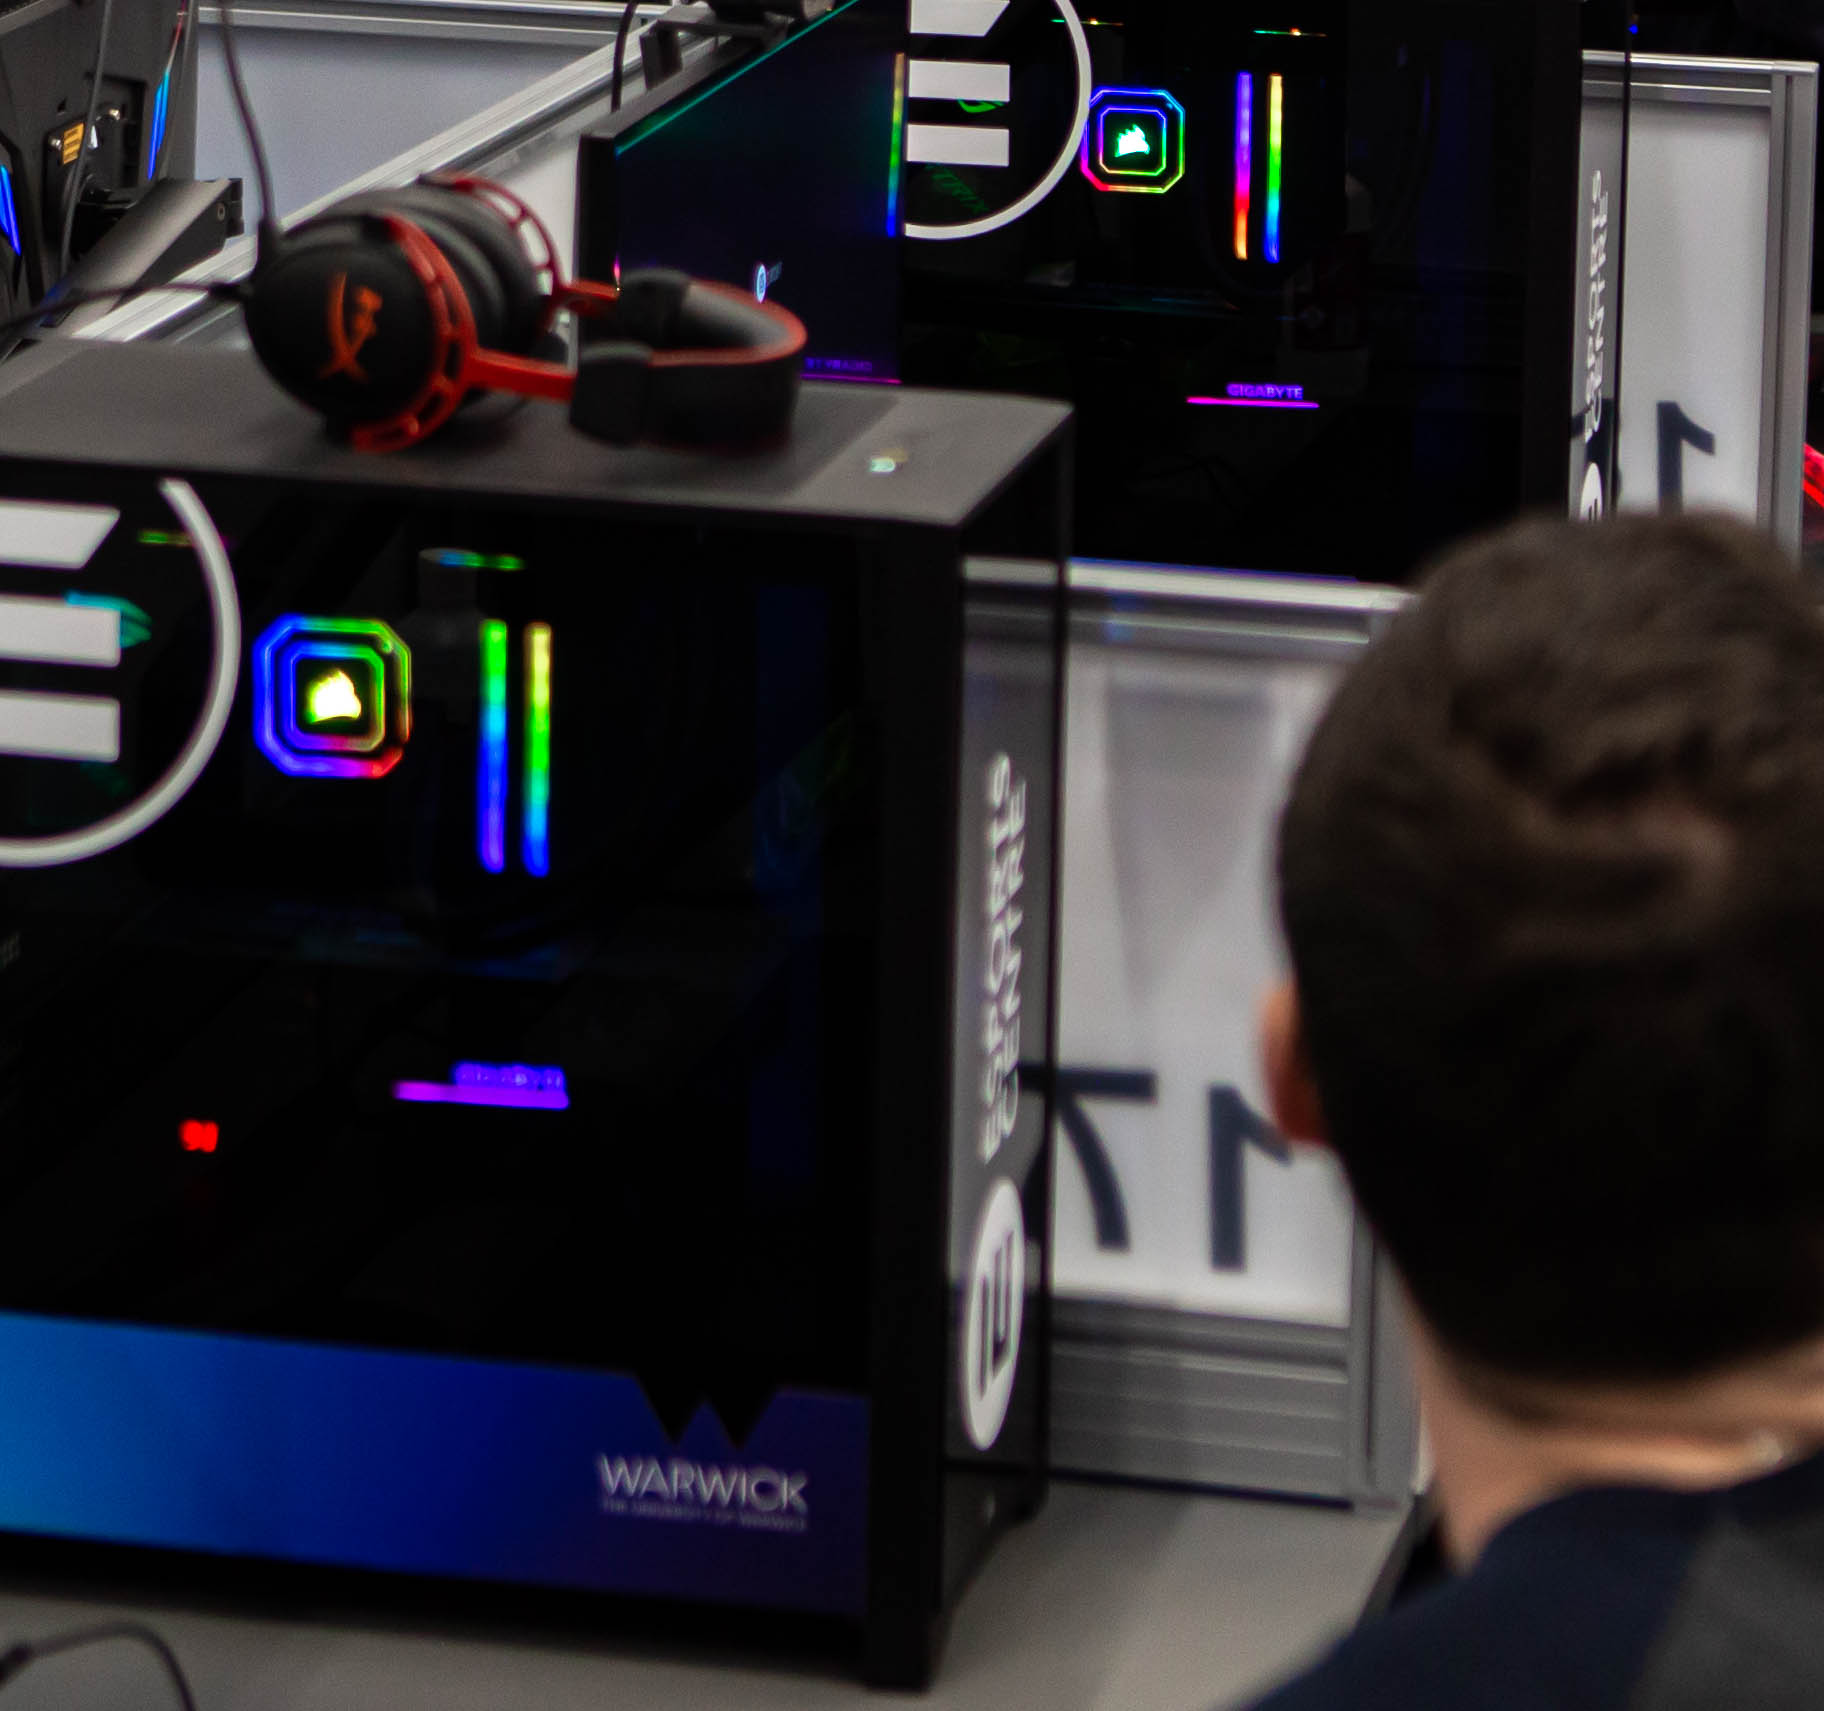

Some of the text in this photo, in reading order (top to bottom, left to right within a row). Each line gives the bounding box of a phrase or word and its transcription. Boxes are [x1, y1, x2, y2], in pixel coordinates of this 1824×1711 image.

[1225, 383, 1304, 400] GIGABYTE
[983, 752, 1012, 1165] ESPORTS
[598, 1454, 808, 1513] WARWICK
